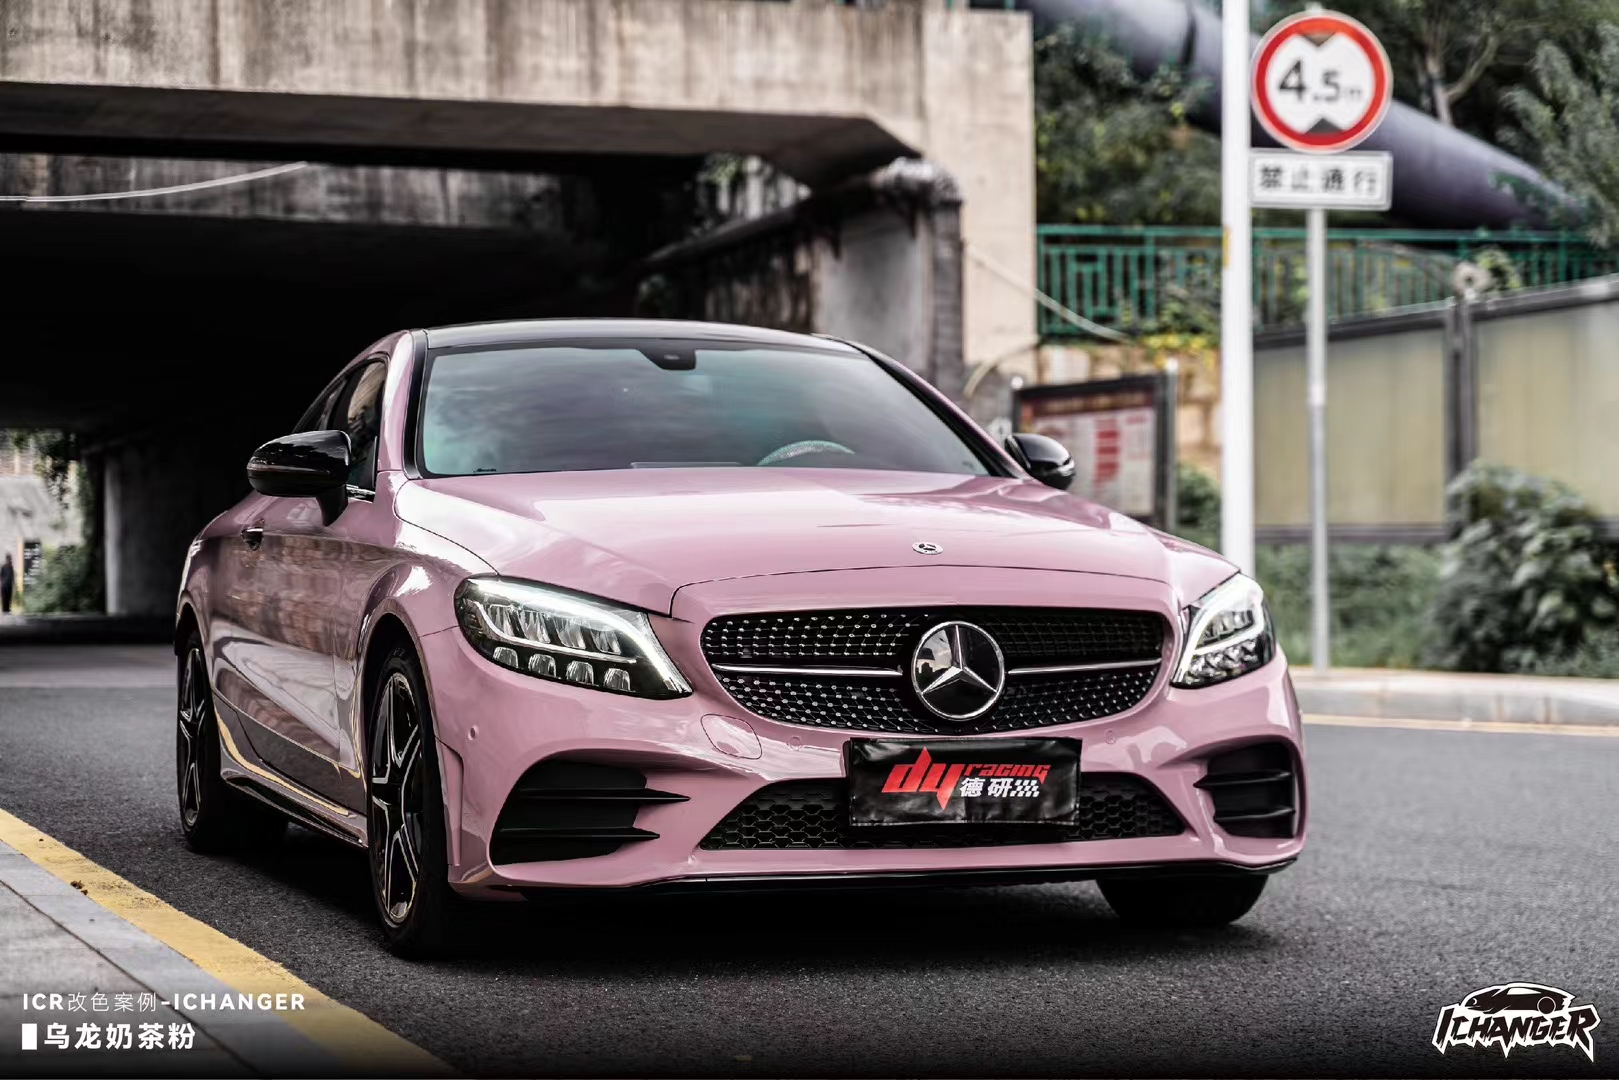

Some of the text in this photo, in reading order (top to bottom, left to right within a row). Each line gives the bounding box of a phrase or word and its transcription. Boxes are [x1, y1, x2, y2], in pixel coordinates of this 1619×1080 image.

[1260, 165, 1377, 194] 禁止通行
[959, 777, 1013, 798] 德研
